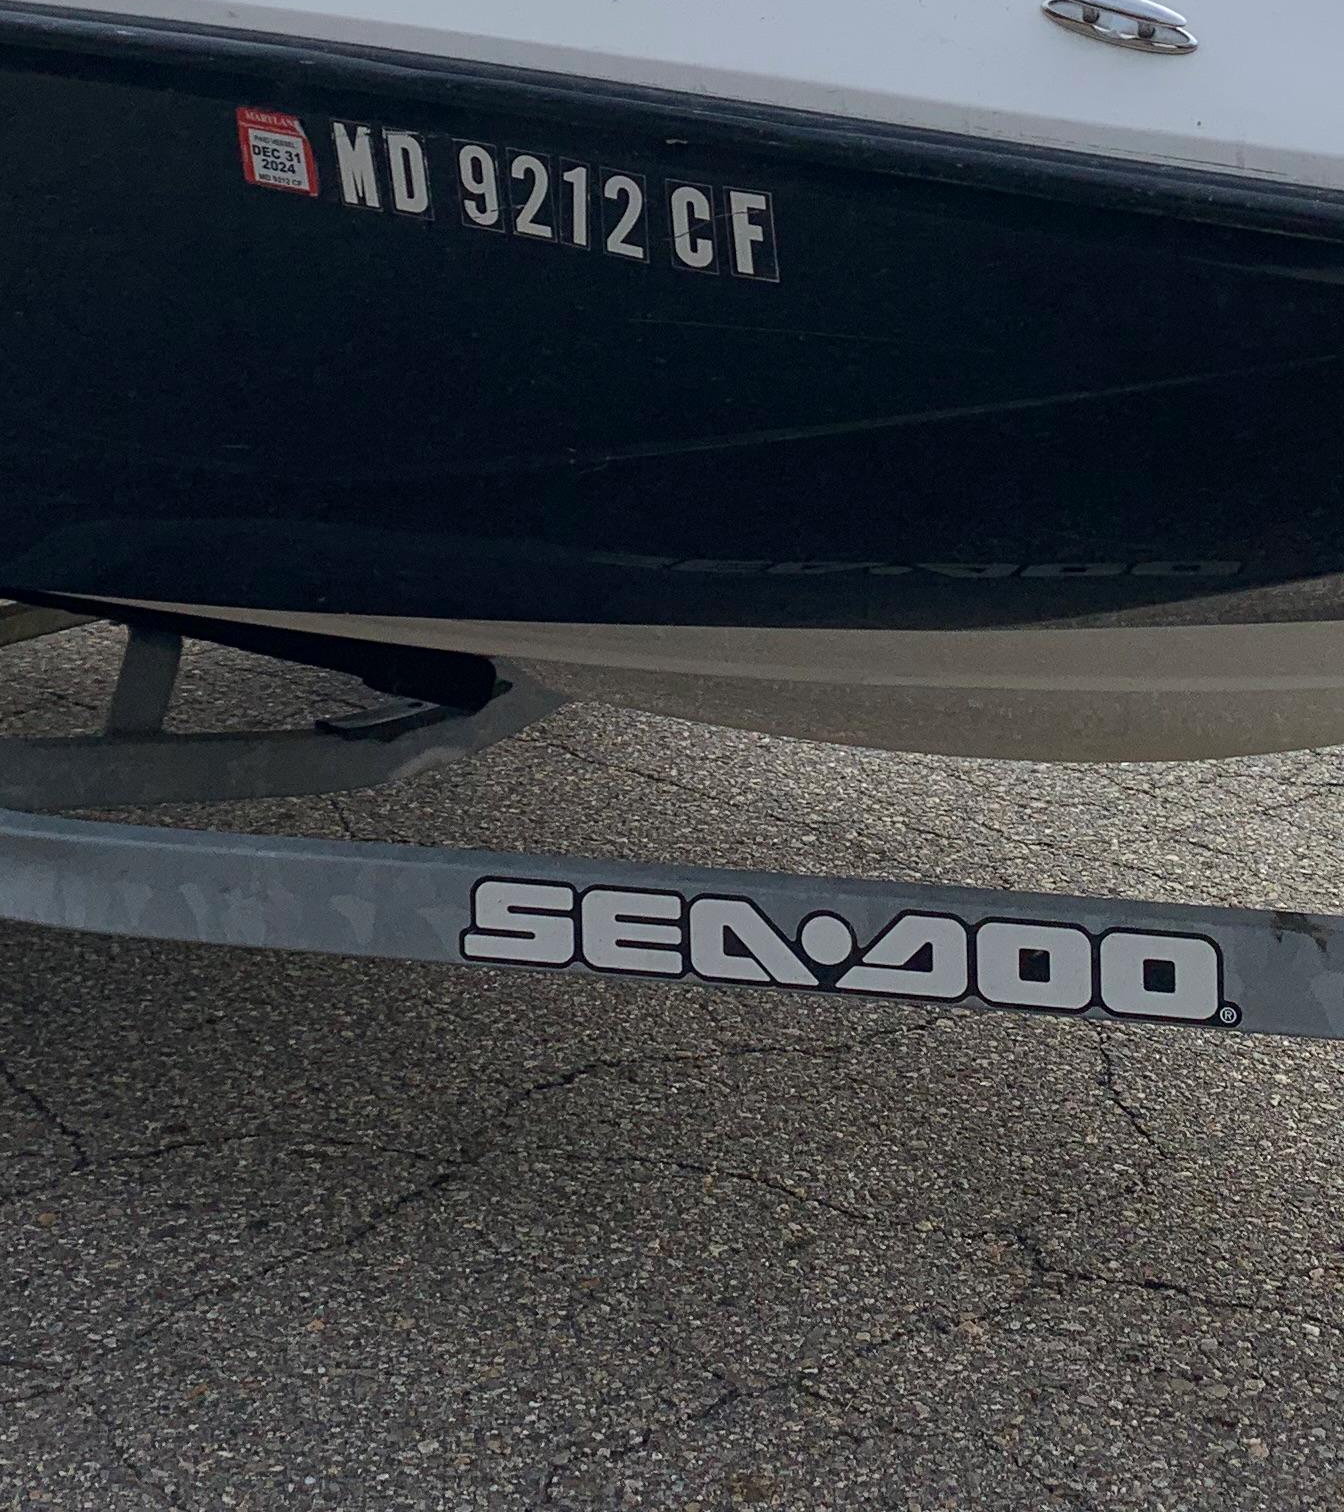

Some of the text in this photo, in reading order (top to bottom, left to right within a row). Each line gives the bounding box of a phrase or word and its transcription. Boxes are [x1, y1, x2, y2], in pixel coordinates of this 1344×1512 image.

[252, 144, 302, 164] DEC 31
[261, 158, 296, 175] 2024
[332, 122, 767, 275] MD 9212 CF
